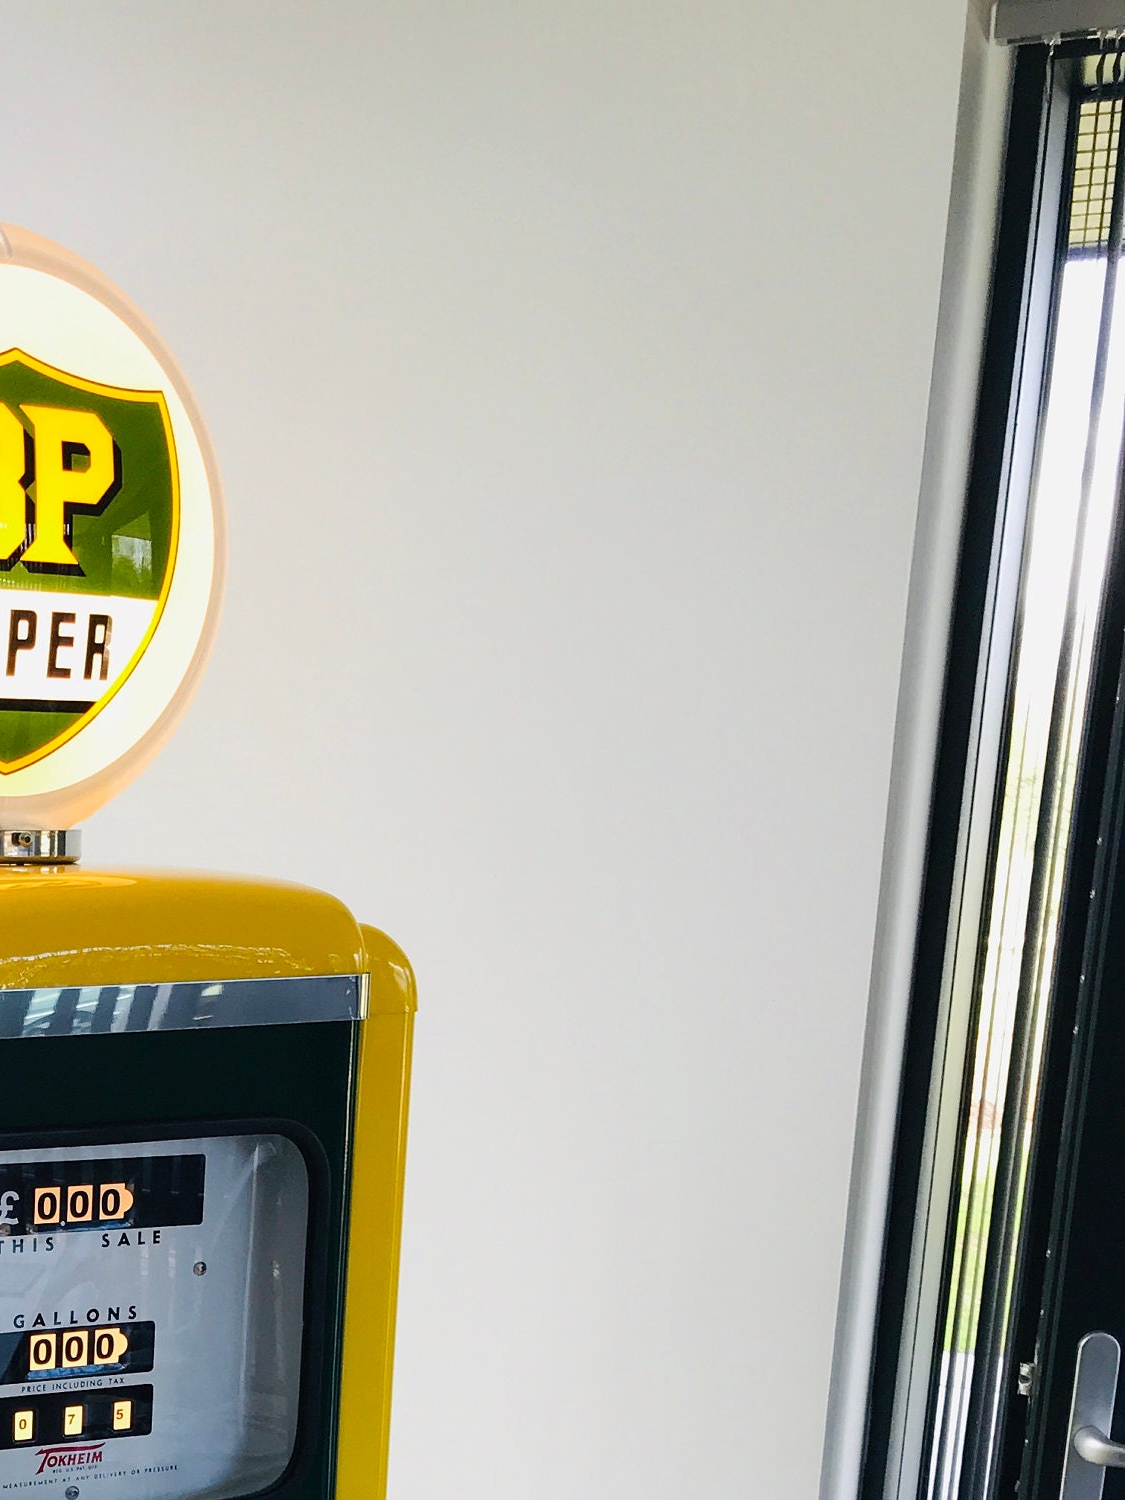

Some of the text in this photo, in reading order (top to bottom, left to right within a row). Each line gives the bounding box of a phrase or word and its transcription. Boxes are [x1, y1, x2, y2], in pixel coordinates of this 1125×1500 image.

[101, 1230, 161, 1248] SALE
[13, 1306, 137, 1328] GALLONS
[21, 1377, 125, 1393] PRICE INCLUDING TAX
[35, 1442, 106, 1475] TOKHEIM
[2, 1478, 57, 1489] MEASUREMENT
[144, 1465, 178, 1473] PRESSURE
